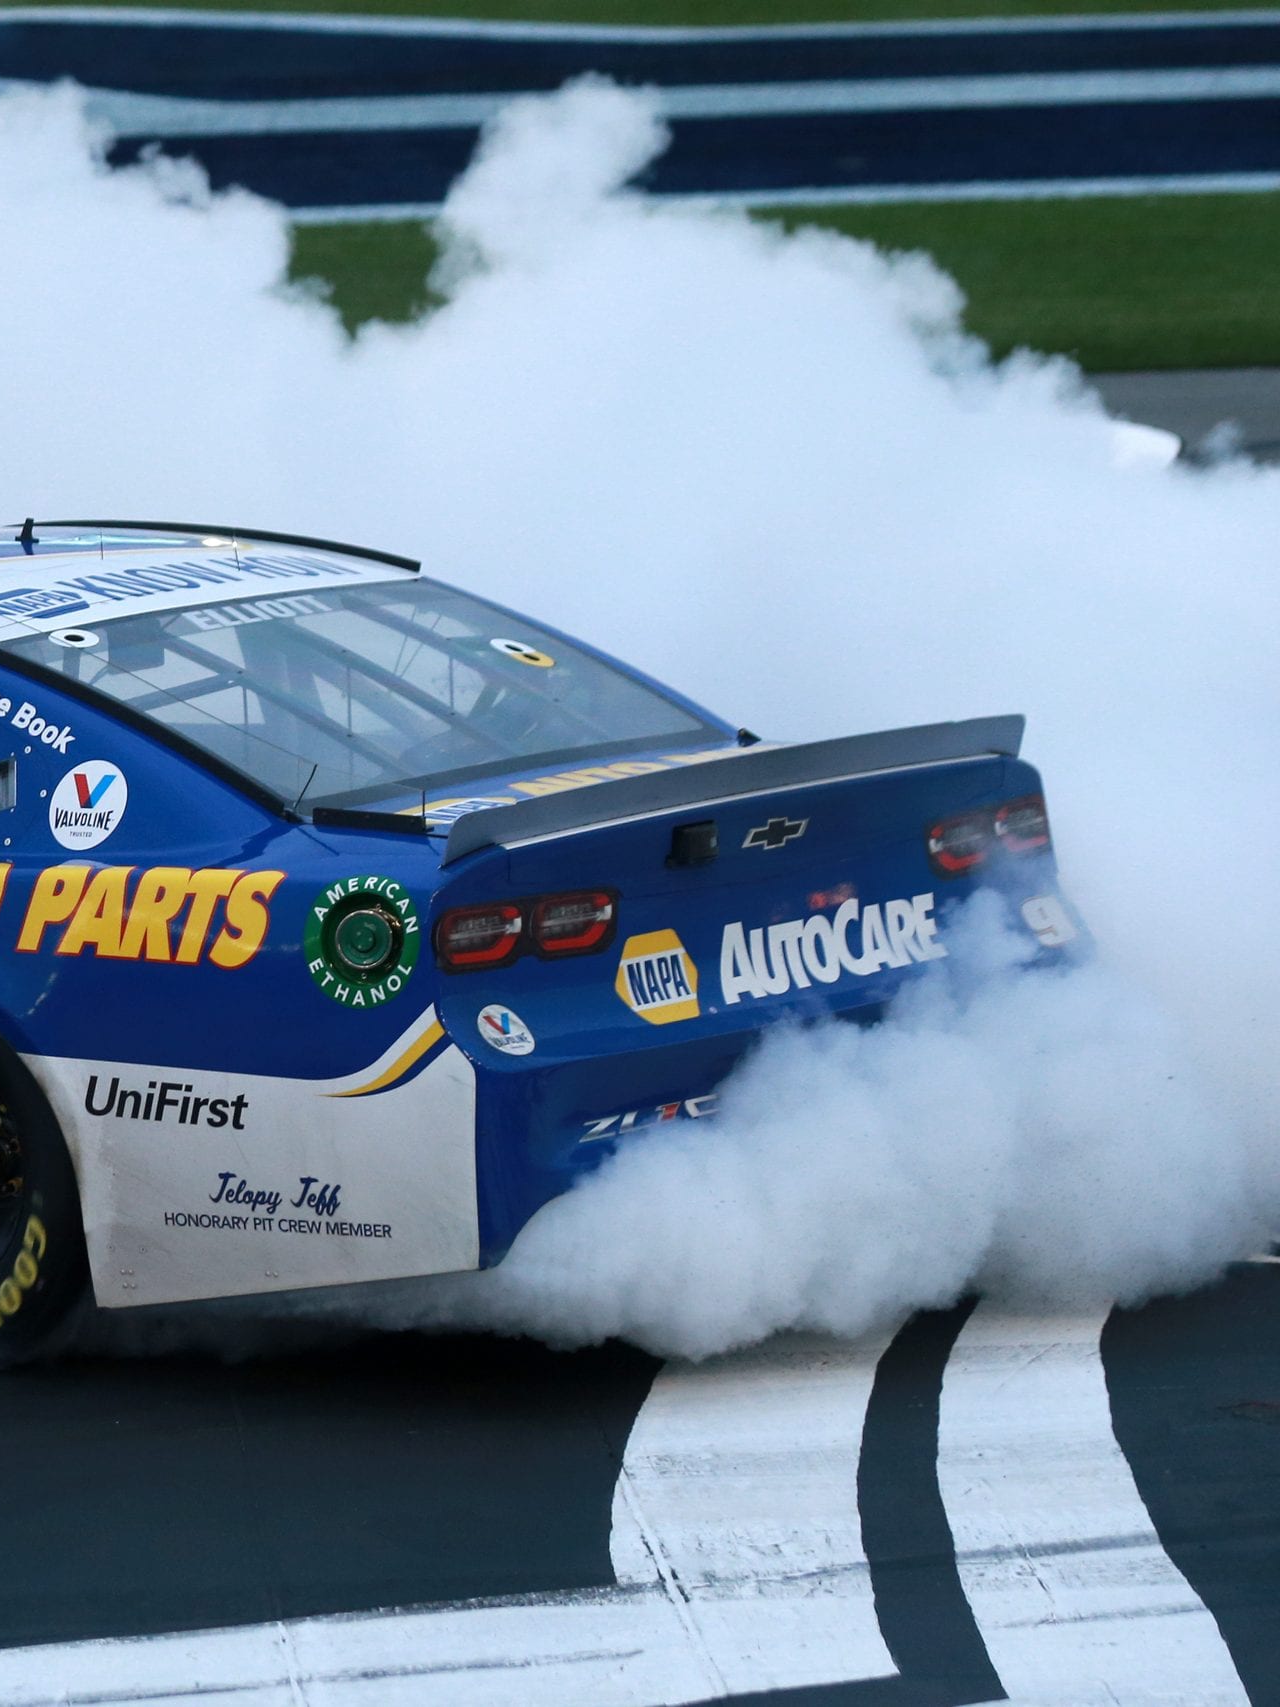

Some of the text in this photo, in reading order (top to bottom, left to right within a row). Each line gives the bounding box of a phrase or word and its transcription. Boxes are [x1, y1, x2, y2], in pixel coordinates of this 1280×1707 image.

[54, 561, 244, 602] KNOW
[181, 594, 333, 631] ELLIOTT
[10, 702, 75, 755] Book
[54, 807, 114, 831] VALVOLINE
[15, 866, 286, 970] PARTS
[313, 876, 419, 935] AMERICAN
[308, 957, 413, 1006] ETHANOL
[626, 952, 690, 1006] NAPA
[84, 1074, 249, 1131] UniFirst
[290, 1176, 342, 1217] Jeff
[164, 1211, 392, 1238] HONORARY PIT CREW MEMBER
